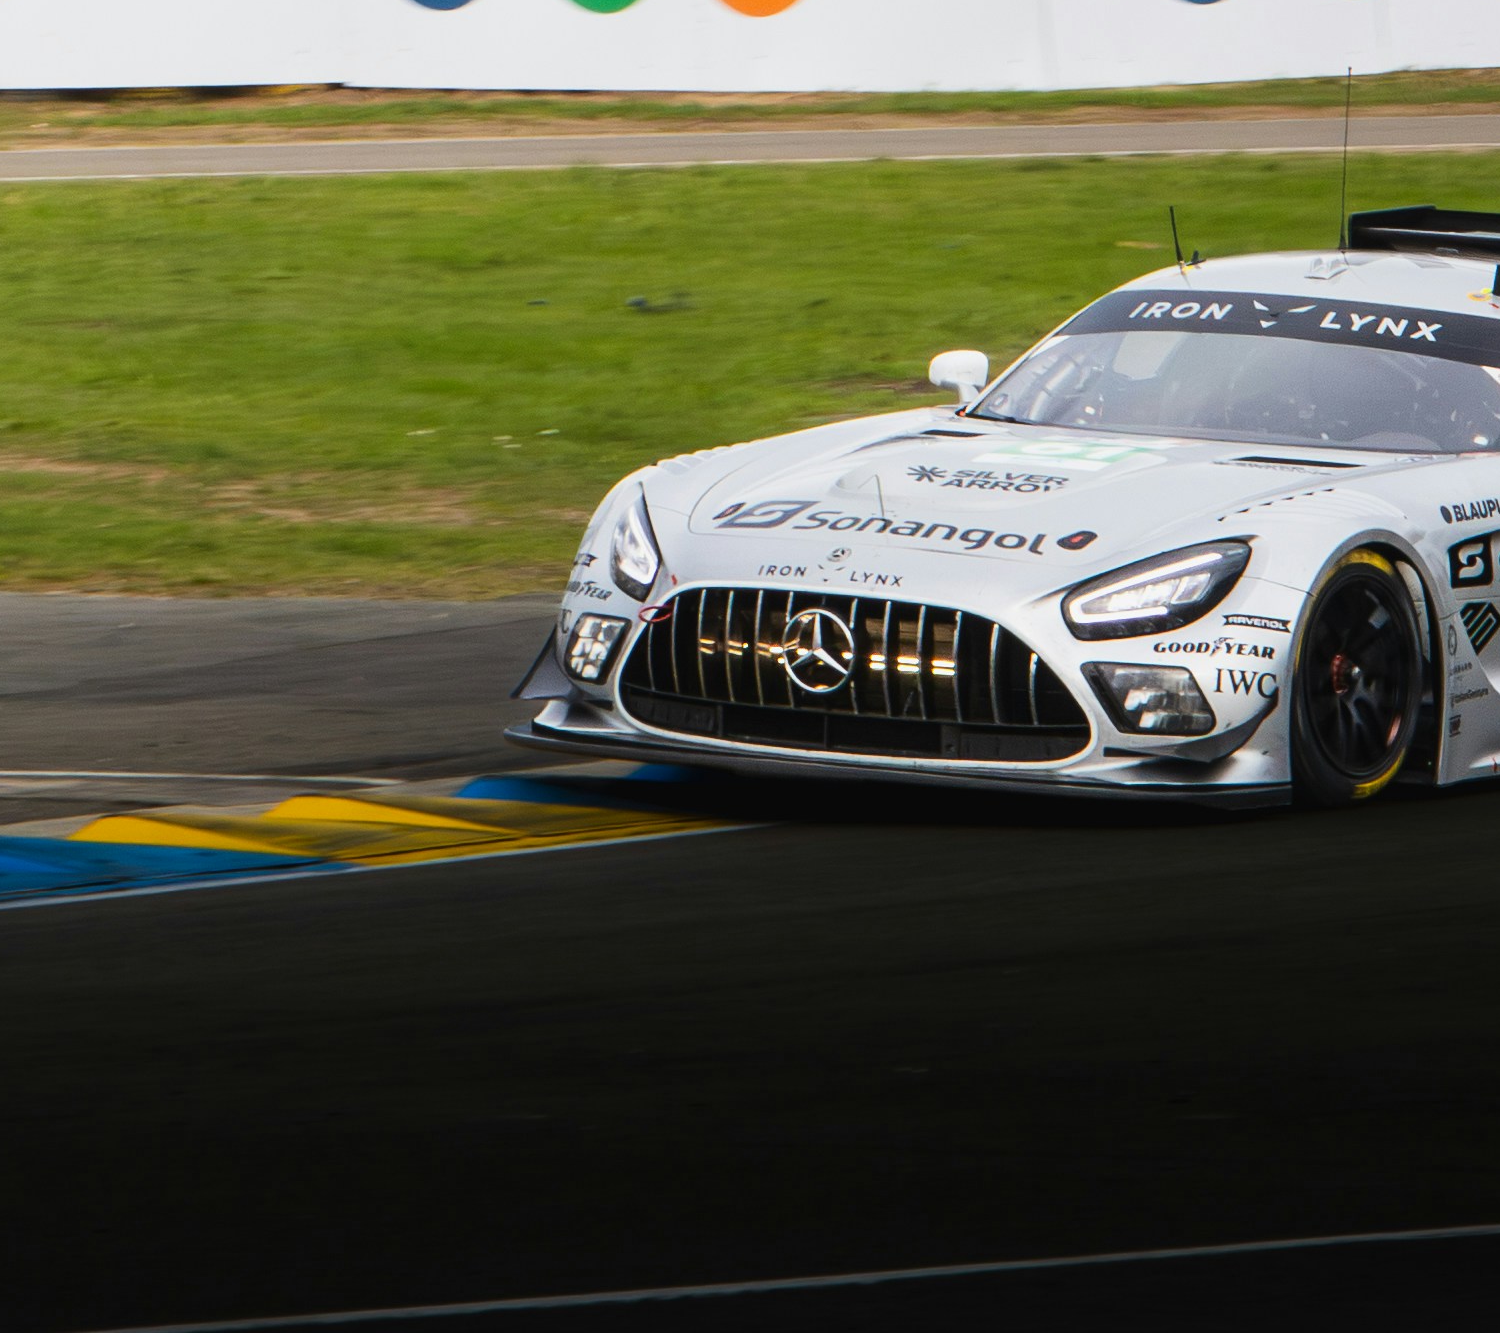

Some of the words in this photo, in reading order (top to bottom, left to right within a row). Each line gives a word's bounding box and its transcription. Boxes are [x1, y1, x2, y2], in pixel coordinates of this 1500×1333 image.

[1129, 301, 1234, 321] IRON
[1319, 310, 1443, 343] LYNX
[940, 478, 1051, 493] ARRO
[952, 469, 1069, 485] SILVER
[793, 510, 1048, 555] Sonangol
[758, 564, 808, 578] IRON
[849, 570, 904, 588] LYNX
[1228, 615, 1287, 631] RAVENOL
[1213, 667, 1278, 699] IWC
